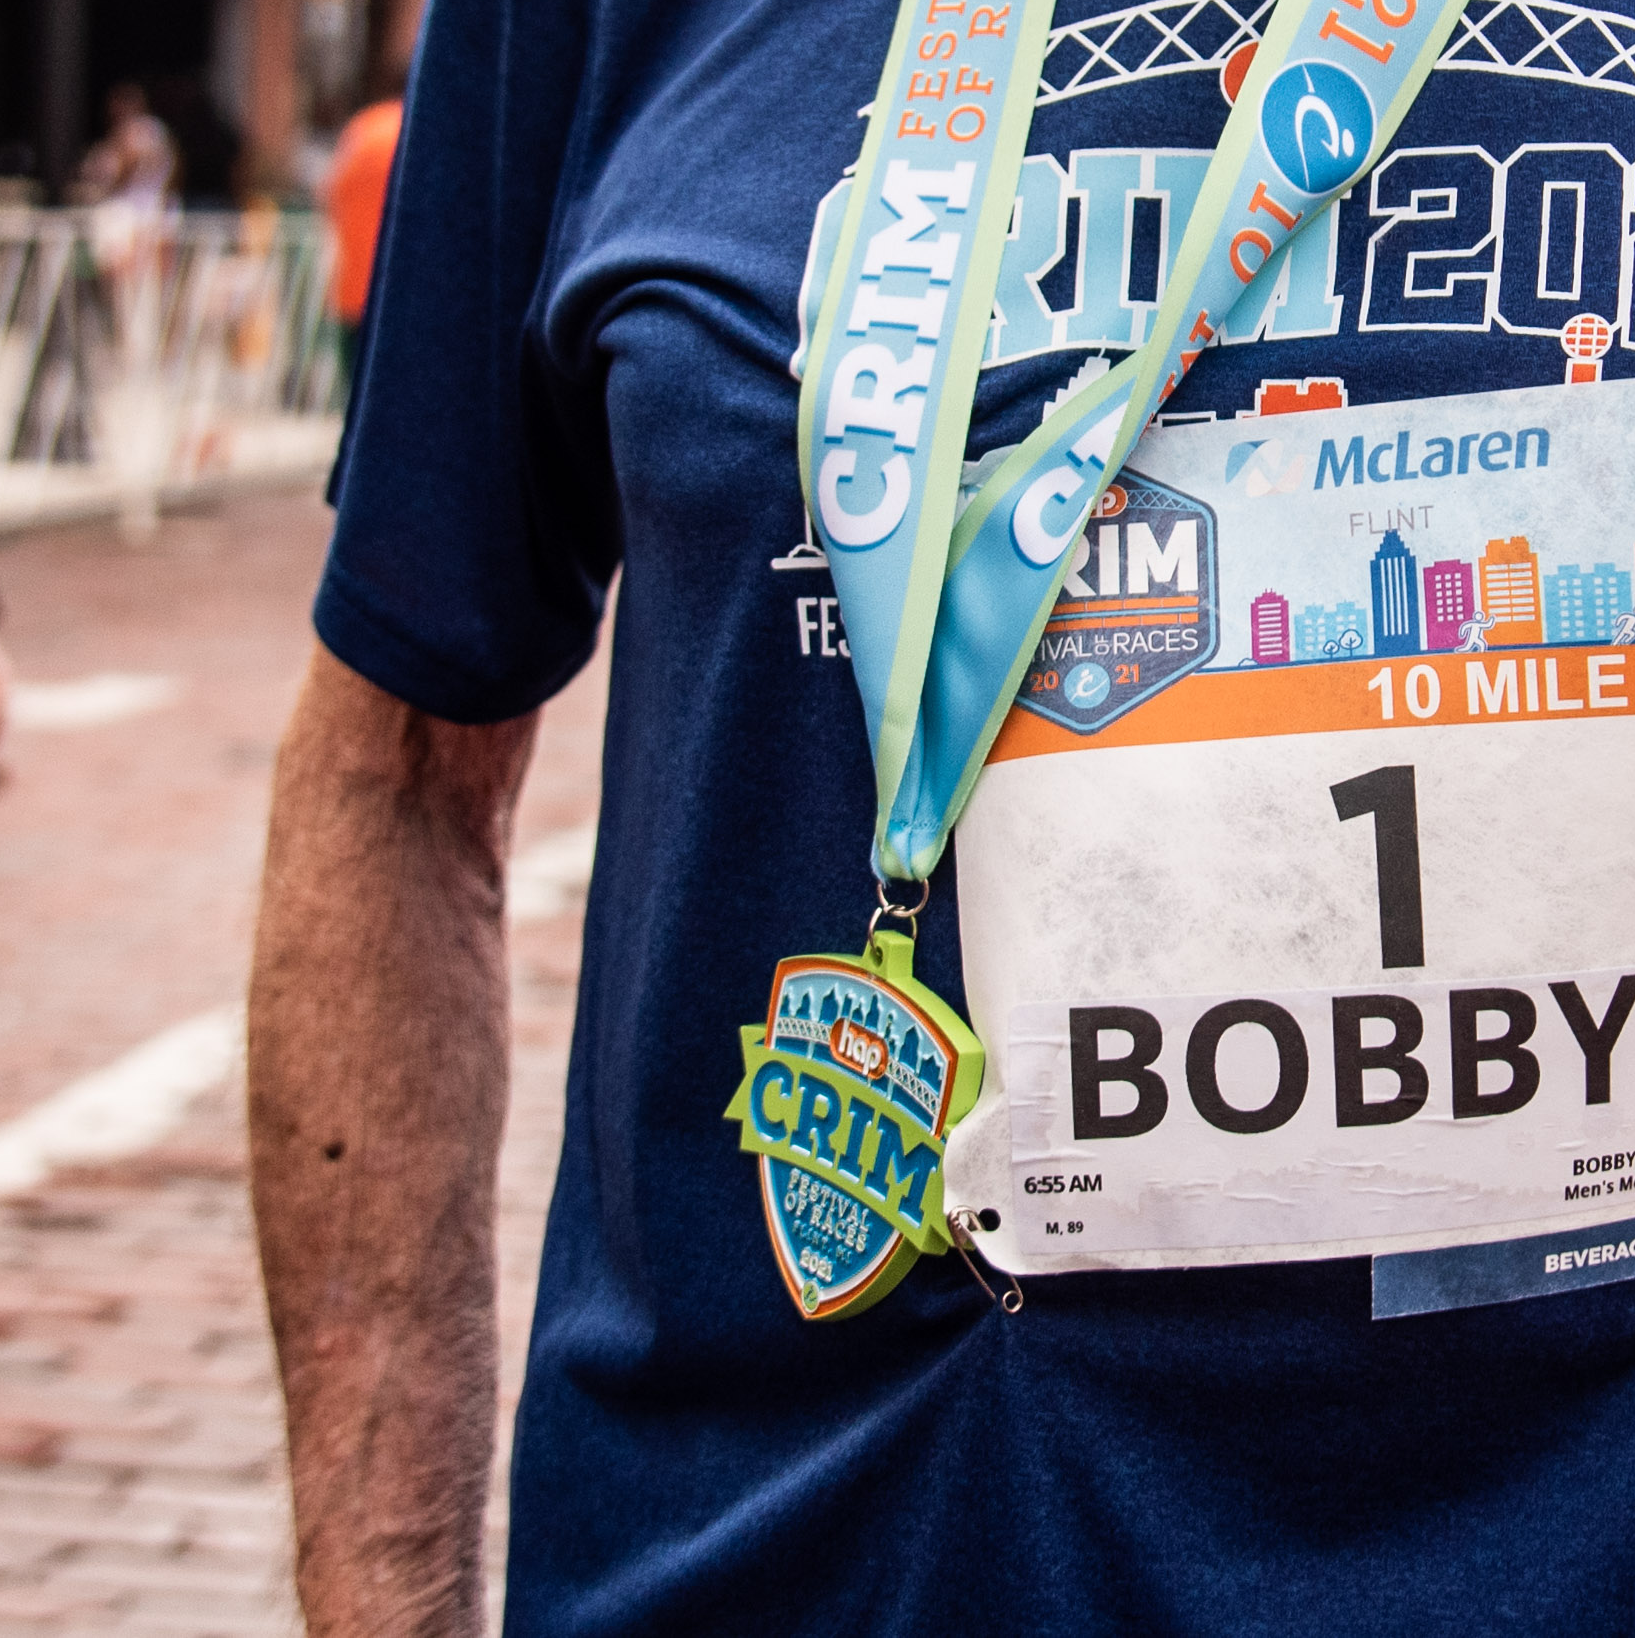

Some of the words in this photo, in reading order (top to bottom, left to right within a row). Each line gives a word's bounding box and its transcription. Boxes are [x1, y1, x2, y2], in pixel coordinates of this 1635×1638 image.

[946, 66, 994, 142] OF
[791, 146, 1351, 380] RIM
[817, 160, 976, 552] CRIM
[1313, 427, 1551, 490] McLaren
[1349, 506, 1434, 537] FLINT
[1032, 638, 1093, 662] IVAL
[1113, 628, 1198, 653] RACES
[1368, 663, 1441, 720] 10
[1466, 654, 1628, 715] MILE
[1329, 764, 1425, 969] 1
[839, 1020, 881, 1075] hap
[751, 1060, 942, 1230] CRIM
[788, 1168, 871, 1232] FESTIVAL
[1024, 1175, 1065, 1195] 6:55
[1068, 1173, 1102, 1193] AM
[1564, 1181, 1614, 1201] Men's
[784, 1191, 807, 1217] OF
[810, 1204, 867, 1253] RACES
[1046, 1222, 1063, 1235] M,
[1067, 1221, 1084, 1234] 89
[799, 1247, 834, 1283] 2021
